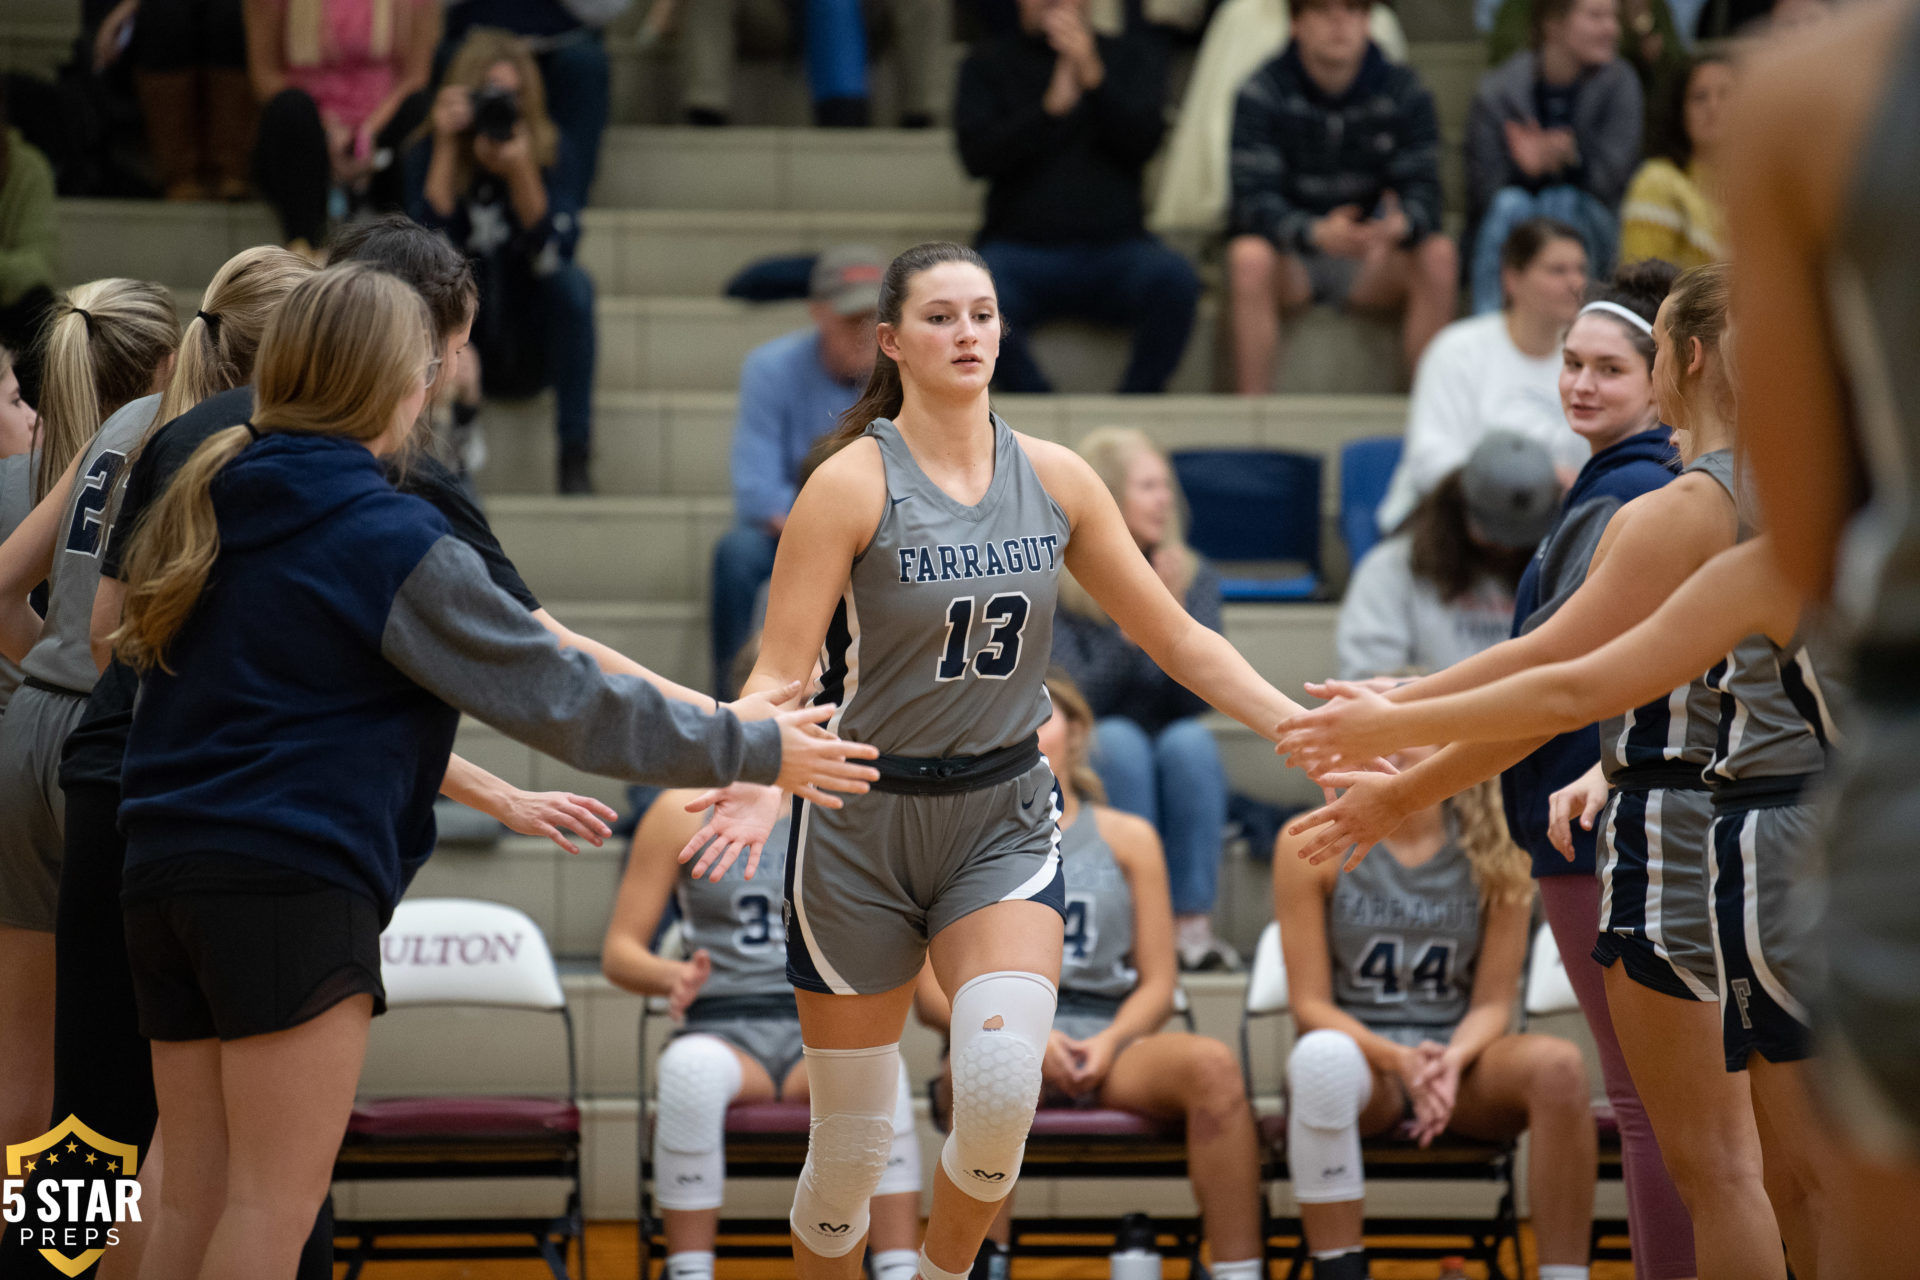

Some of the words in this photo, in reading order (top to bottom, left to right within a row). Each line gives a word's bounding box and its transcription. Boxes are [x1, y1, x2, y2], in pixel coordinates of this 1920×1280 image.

[65, 449, 131, 559] 2
[898, 534, 1058, 583] FARRAGUT
[935, 591, 1031, 682] 13
[381, 932, 522, 966] ULTON
[731, 886, 787, 955] 3
[1352, 933, 1460, 1004] 44
[1731, 978, 1753, 1030] F
